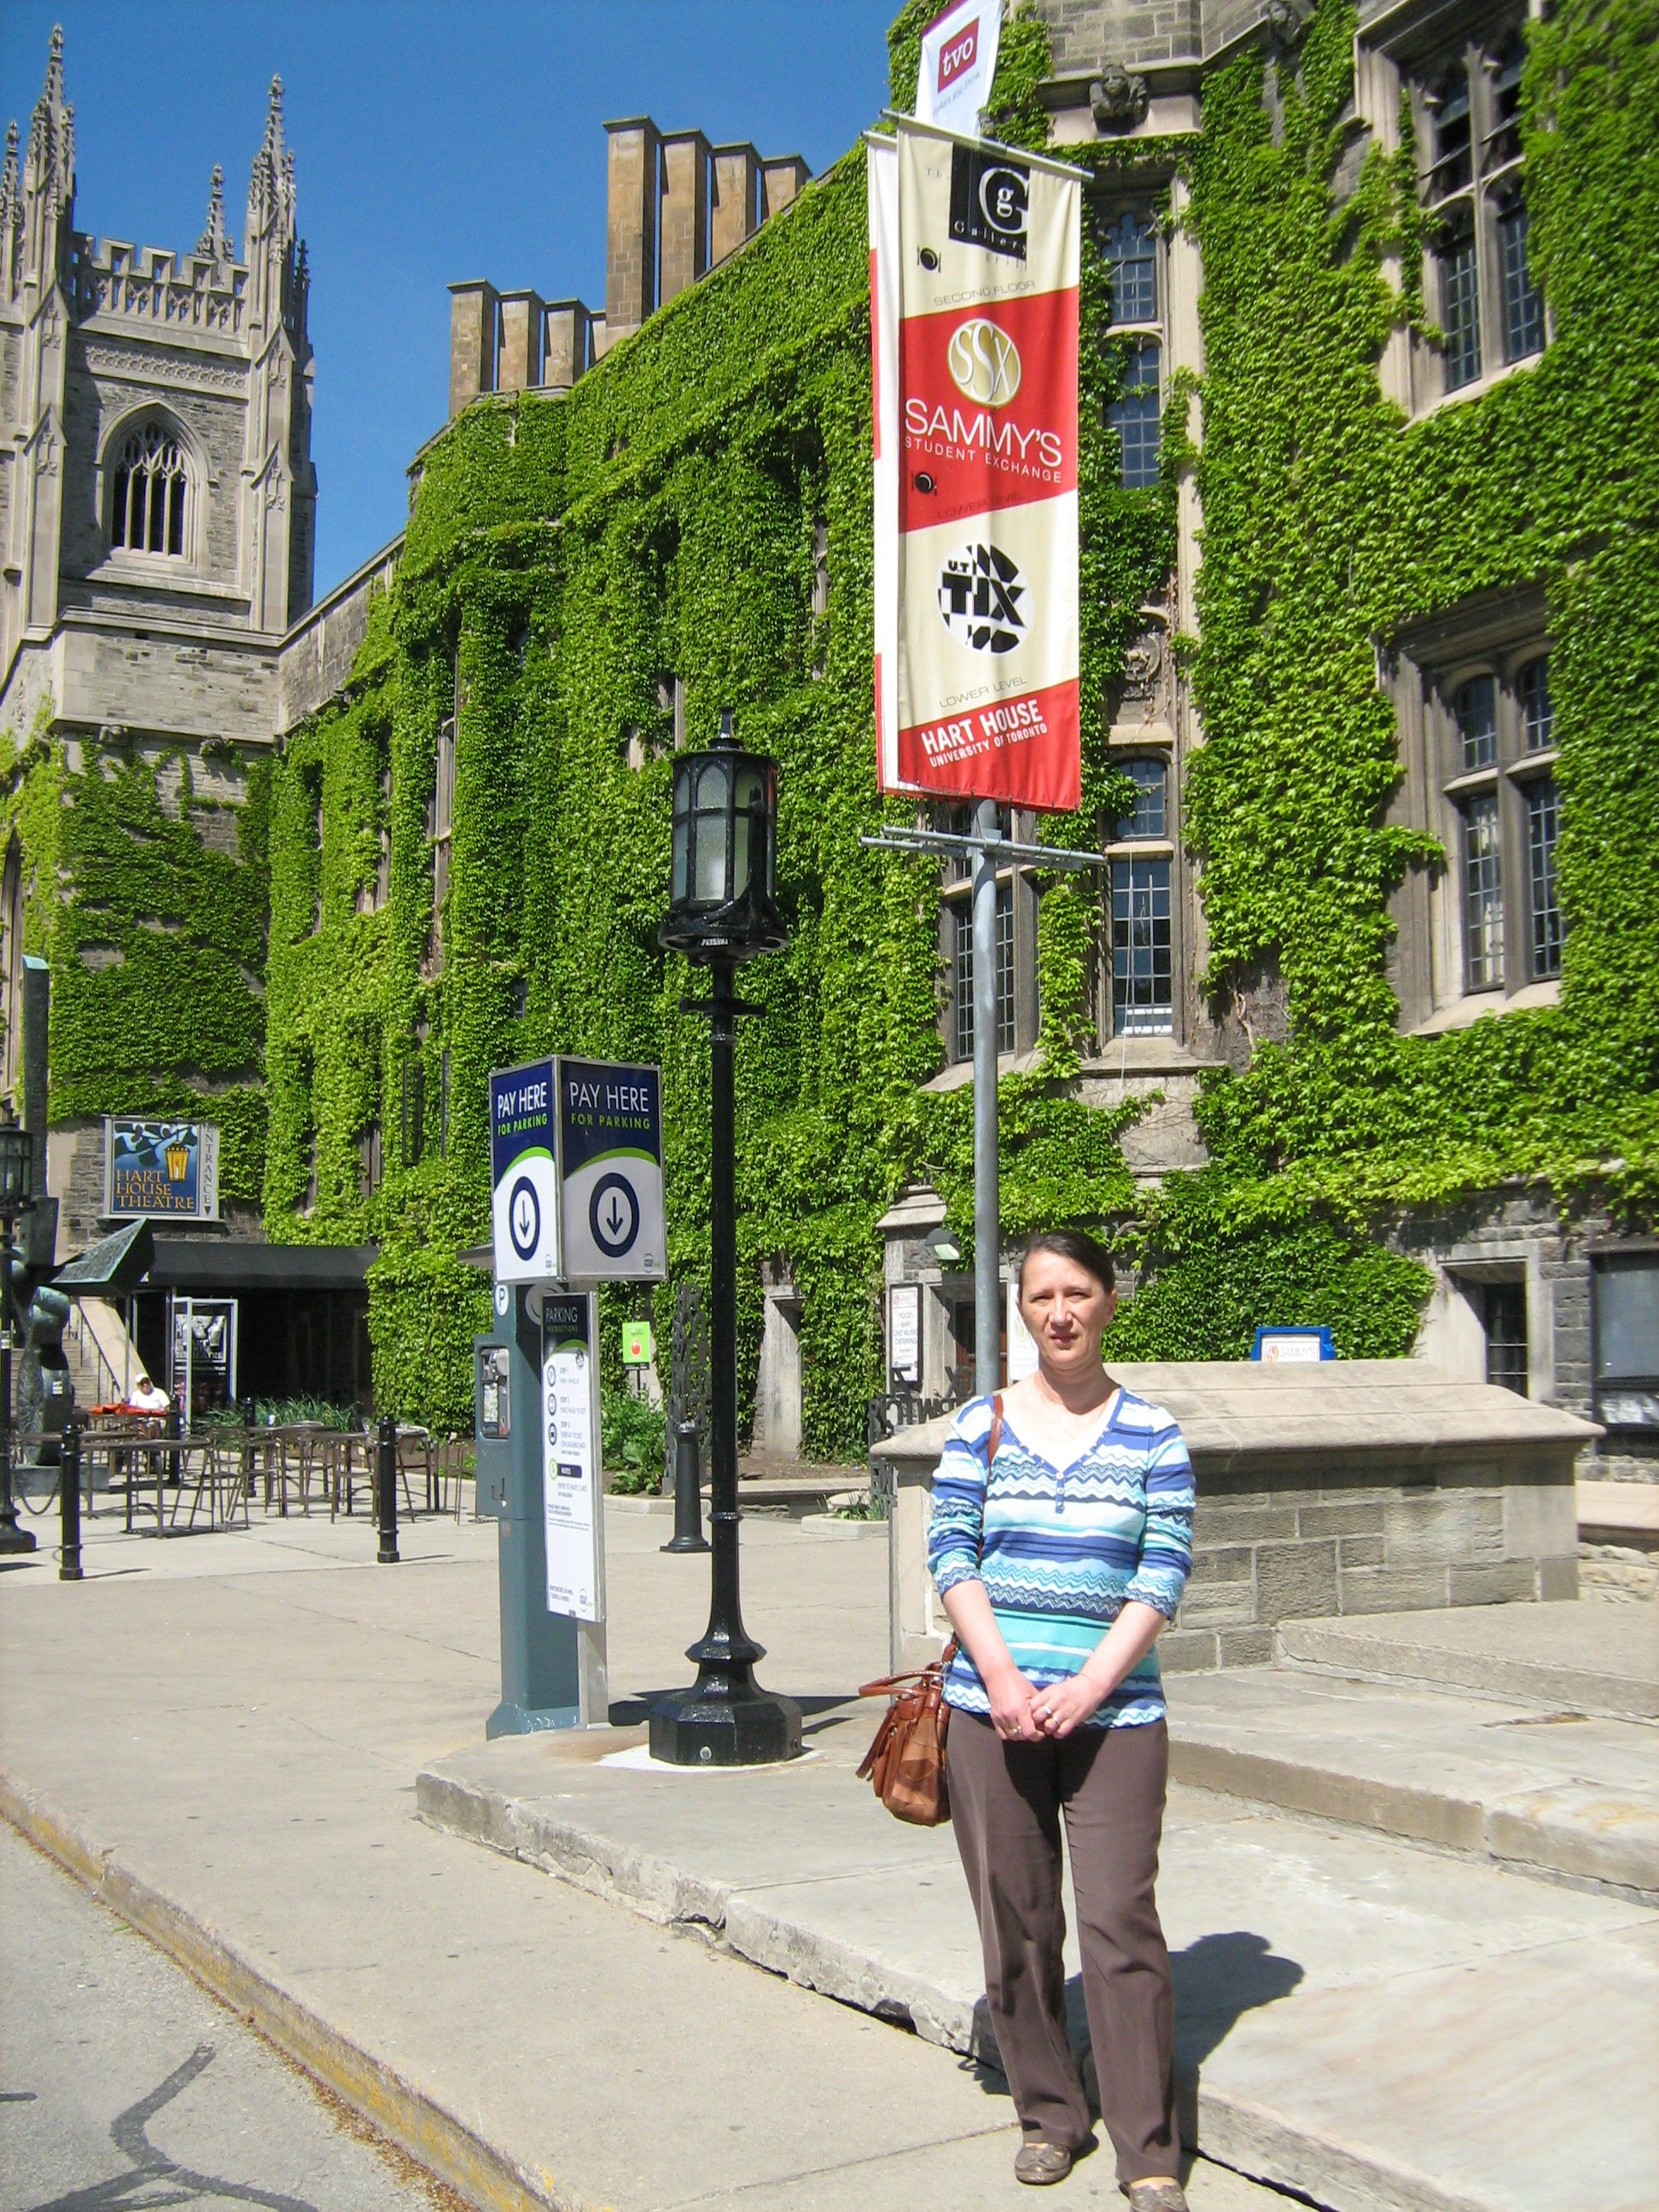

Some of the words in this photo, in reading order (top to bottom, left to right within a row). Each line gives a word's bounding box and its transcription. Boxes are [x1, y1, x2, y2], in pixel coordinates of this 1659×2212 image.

[942, 37, 974, 77] tvo
[954, 219, 1027, 255] Gallery
[934, 286, 992, 306] SECOND
[993, 281, 1036, 298] FLOOR
[905, 399, 1062, 468] SAMMY'S
[905, 436, 975, 462] STUDENT
[985, 454, 1062, 484] EXCHANGE
[942, 572, 1027, 630] TIX
[940, 686, 990, 709] LOWER
[994, 676, 1027, 692] LEVEL
[921, 719, 975, 755] HART
[979, 699, 1044, 736] HOUSE
[928, 739, 991, 768] UNIVERSITY
[994, 733, 1005, 748] OF
[1006, 723, 1048, 744] TORONTO
[498, 1092, 516, 1119] PAY
[519, 1081, 548, 1114] HERE
[569, 1081, 601, 1109] PAY
[607, 1085, 649, 1113] HERE
[498, 1122, 511, 1137] FOR
[514, 1113, 548, 1132] PARKING
[571, 1113, 594, 1126] FOR
[599, 1115, 650, 1130] PARKING
[115, 1168, 165, 1184] HART
[202, 1123, 213, 1204] ENTRANCE
[115, 1182, 172, 1196] HOUSE
[115, 1195, 195, 1209] THEATRE
[498, 1287, 506, 1308] P
[545, 1306, 579, 1323] PARKING
